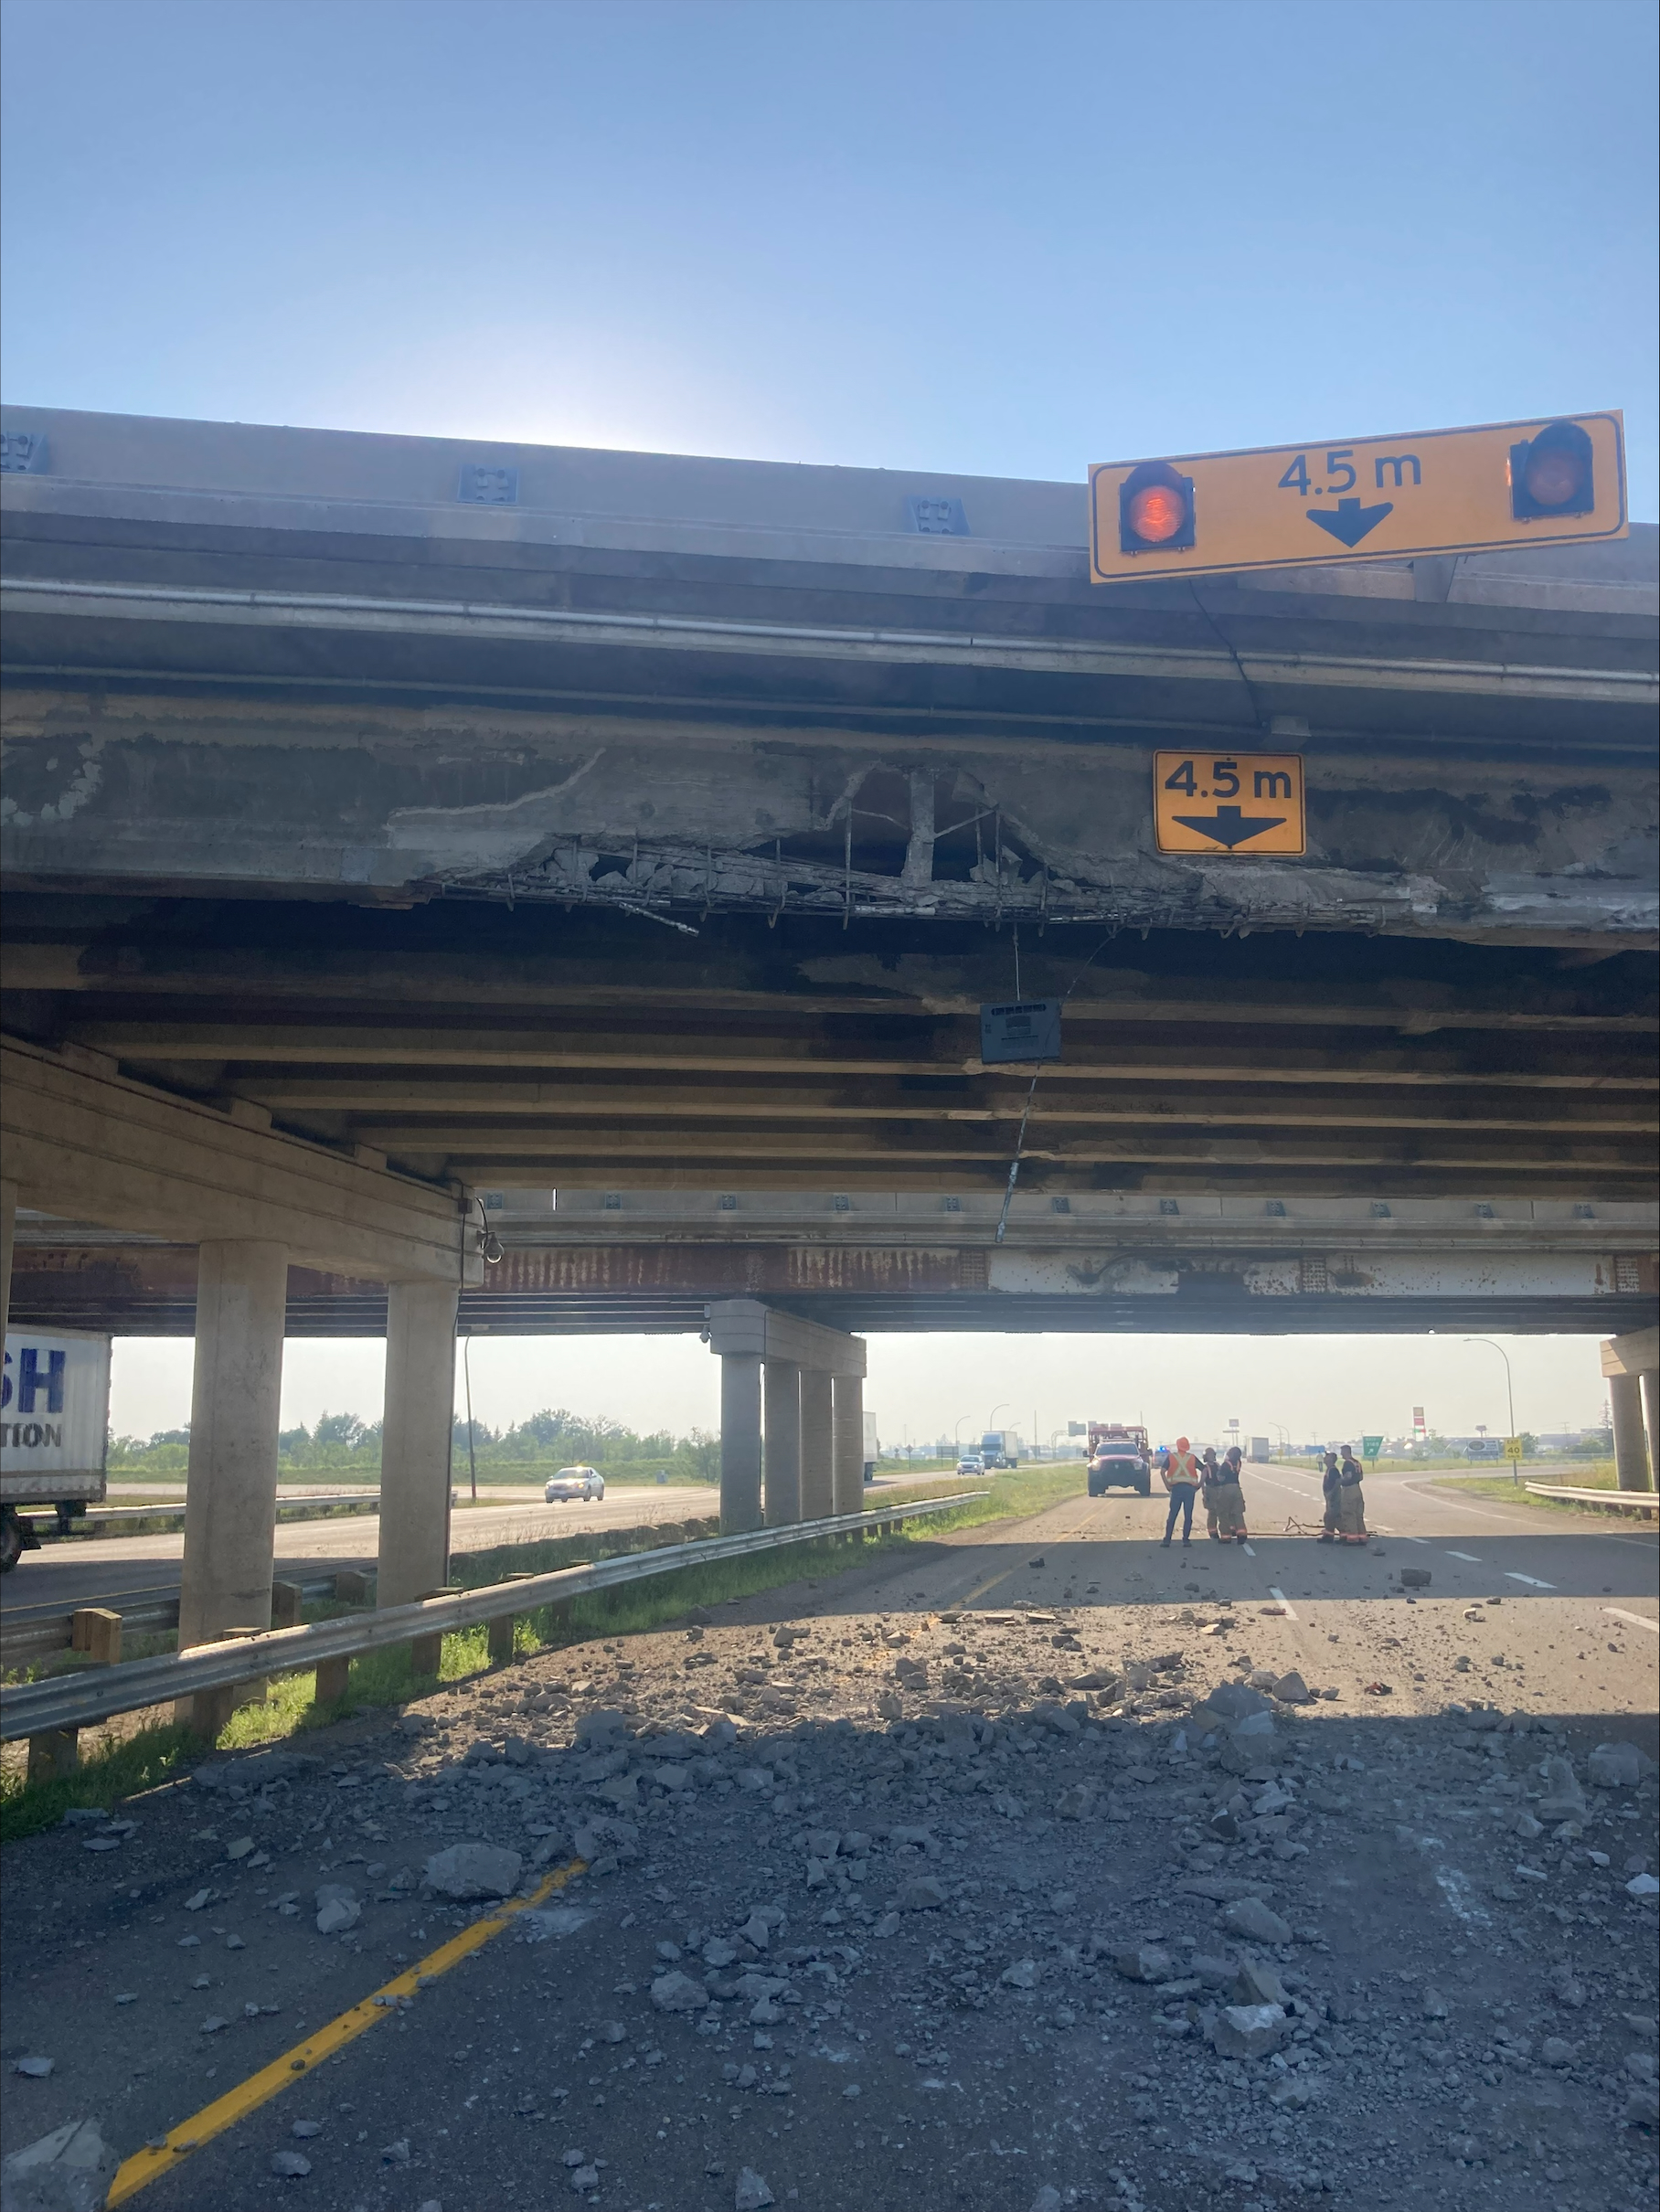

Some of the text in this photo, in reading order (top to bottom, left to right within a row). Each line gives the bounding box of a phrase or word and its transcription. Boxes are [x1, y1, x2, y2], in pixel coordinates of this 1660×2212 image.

[1278, 450, 1421, 495] 4.5 m
[1165, 760, 1292, 798] 4.5 m
